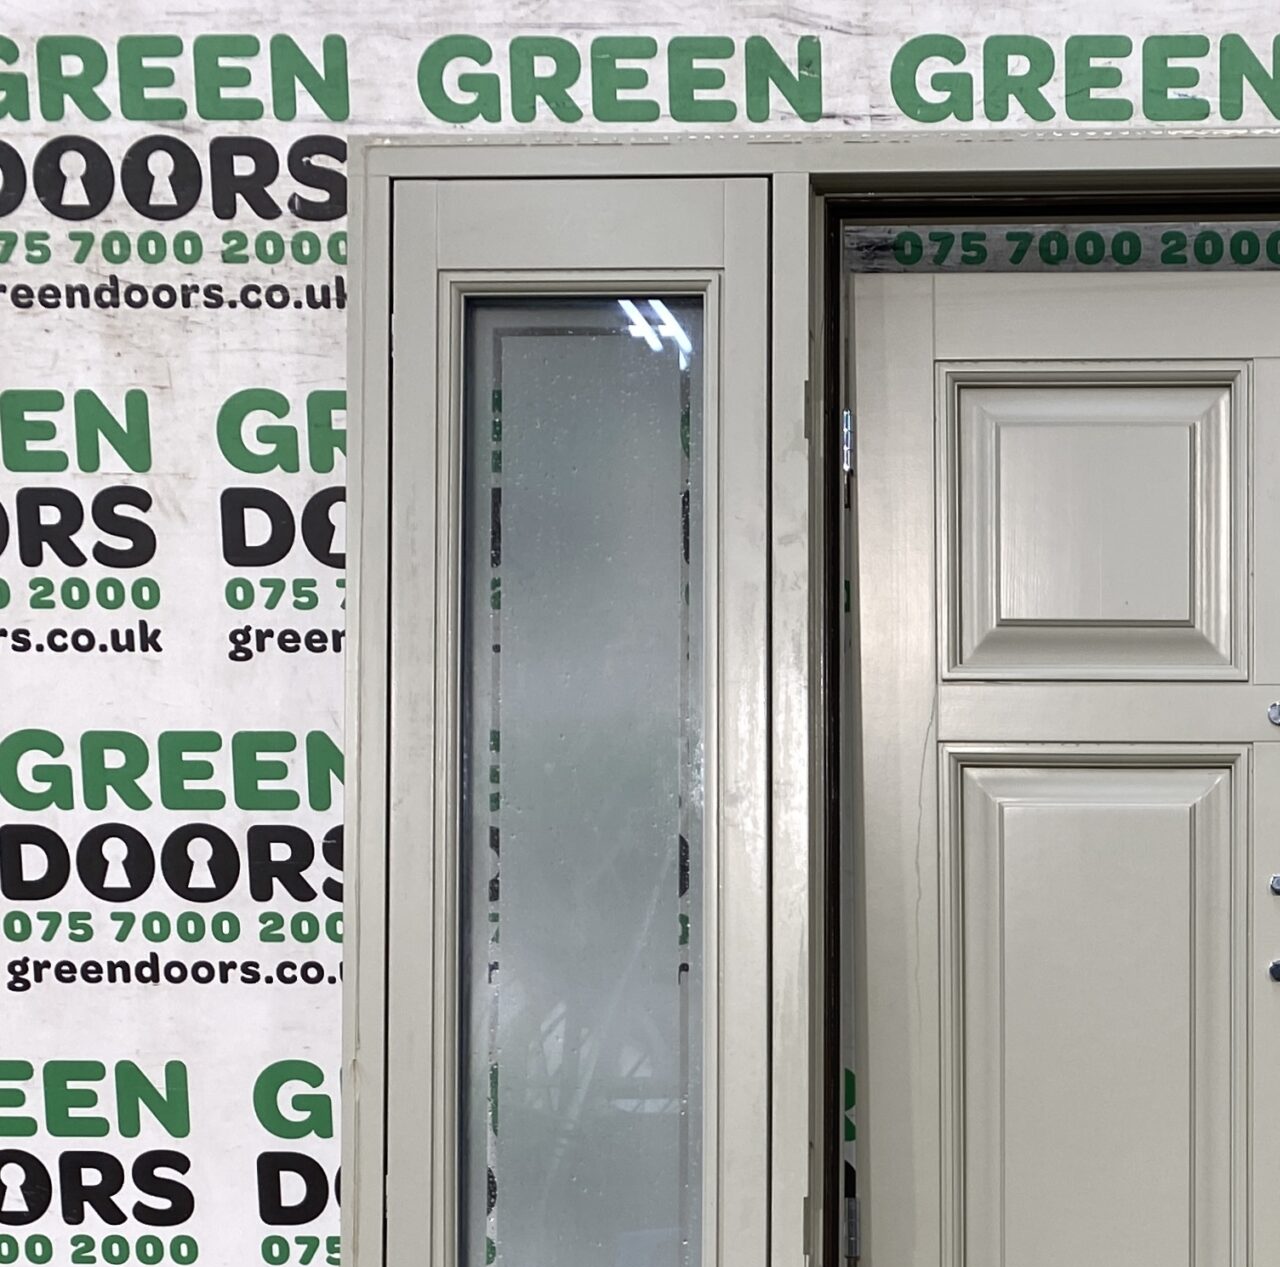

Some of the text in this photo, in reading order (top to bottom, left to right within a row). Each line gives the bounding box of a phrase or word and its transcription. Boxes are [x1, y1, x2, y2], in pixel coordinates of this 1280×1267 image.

[418, 34, 823, 123] GREEN
[69, 231, 202, 264] 7000
[894, 231, 987, 265] 075
[1006, 231, 1141, 266] 7000
[0, 486, 156, 568] RS
[29, 578, 160, 609] 2000
[226, 578, 318, 610] 075
[3, 911, 94, 942] 075
[111, 912, 240, 942] 7000
[8, 952, 343, 992] greendoors.co.
[257, 1152, 341, 1225] D
[71, 1235, 198, 1265] 2000
